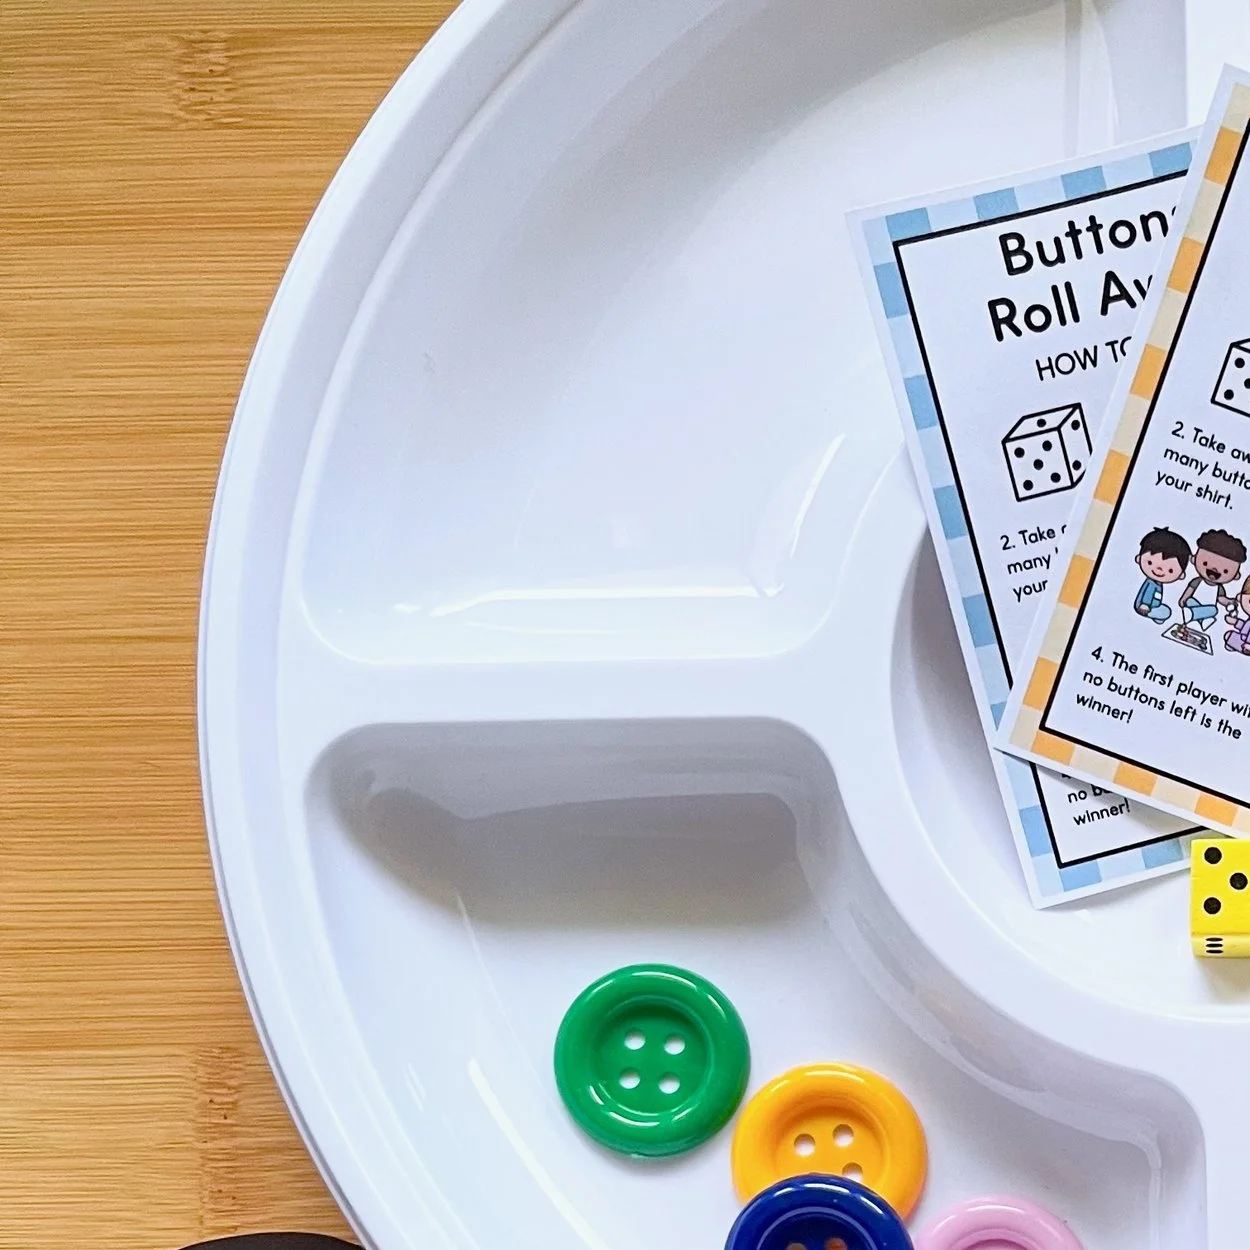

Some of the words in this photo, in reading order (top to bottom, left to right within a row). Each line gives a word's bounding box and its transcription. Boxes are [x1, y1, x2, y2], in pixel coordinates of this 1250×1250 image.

[998, 205, 1177, 276] Button
[987, 281, 1080, 342] Roll
[1035, 345, 1098, 381] HOW
[1171, 420, 1185, 440] 2.
[1192, 426, 1226, 454] Take
[1163, 447, 1210, 477] many
[1155, 470, 1193, 492] your
[1195, 484, 1233, 510] shirt.
[1000, 535, 1016, 550] 2.
[1018, 526, 1056, 545] Take
[1007, 554, 1051, 575] many
[1013, 580, 1048, 603] your
[1091, 646, 1104, 663] 4.
[1112, 651, 1139, 675] The
[1142, 664, 1174, 688] first
[1175, 680, 1228, 707] player
[1076, 693, 1134, 724] winner!
[1082, 671, 1104, 687] no
[1106, 675, 1166, 711] buttons
[1169, 699, 1197, 723] left
[1199, 712, 1213, 729] is
[1217, 718, 1242, 740] the
[1067, 790, 1087, 803] no
[1073, 797, 1130, 826] winner!
